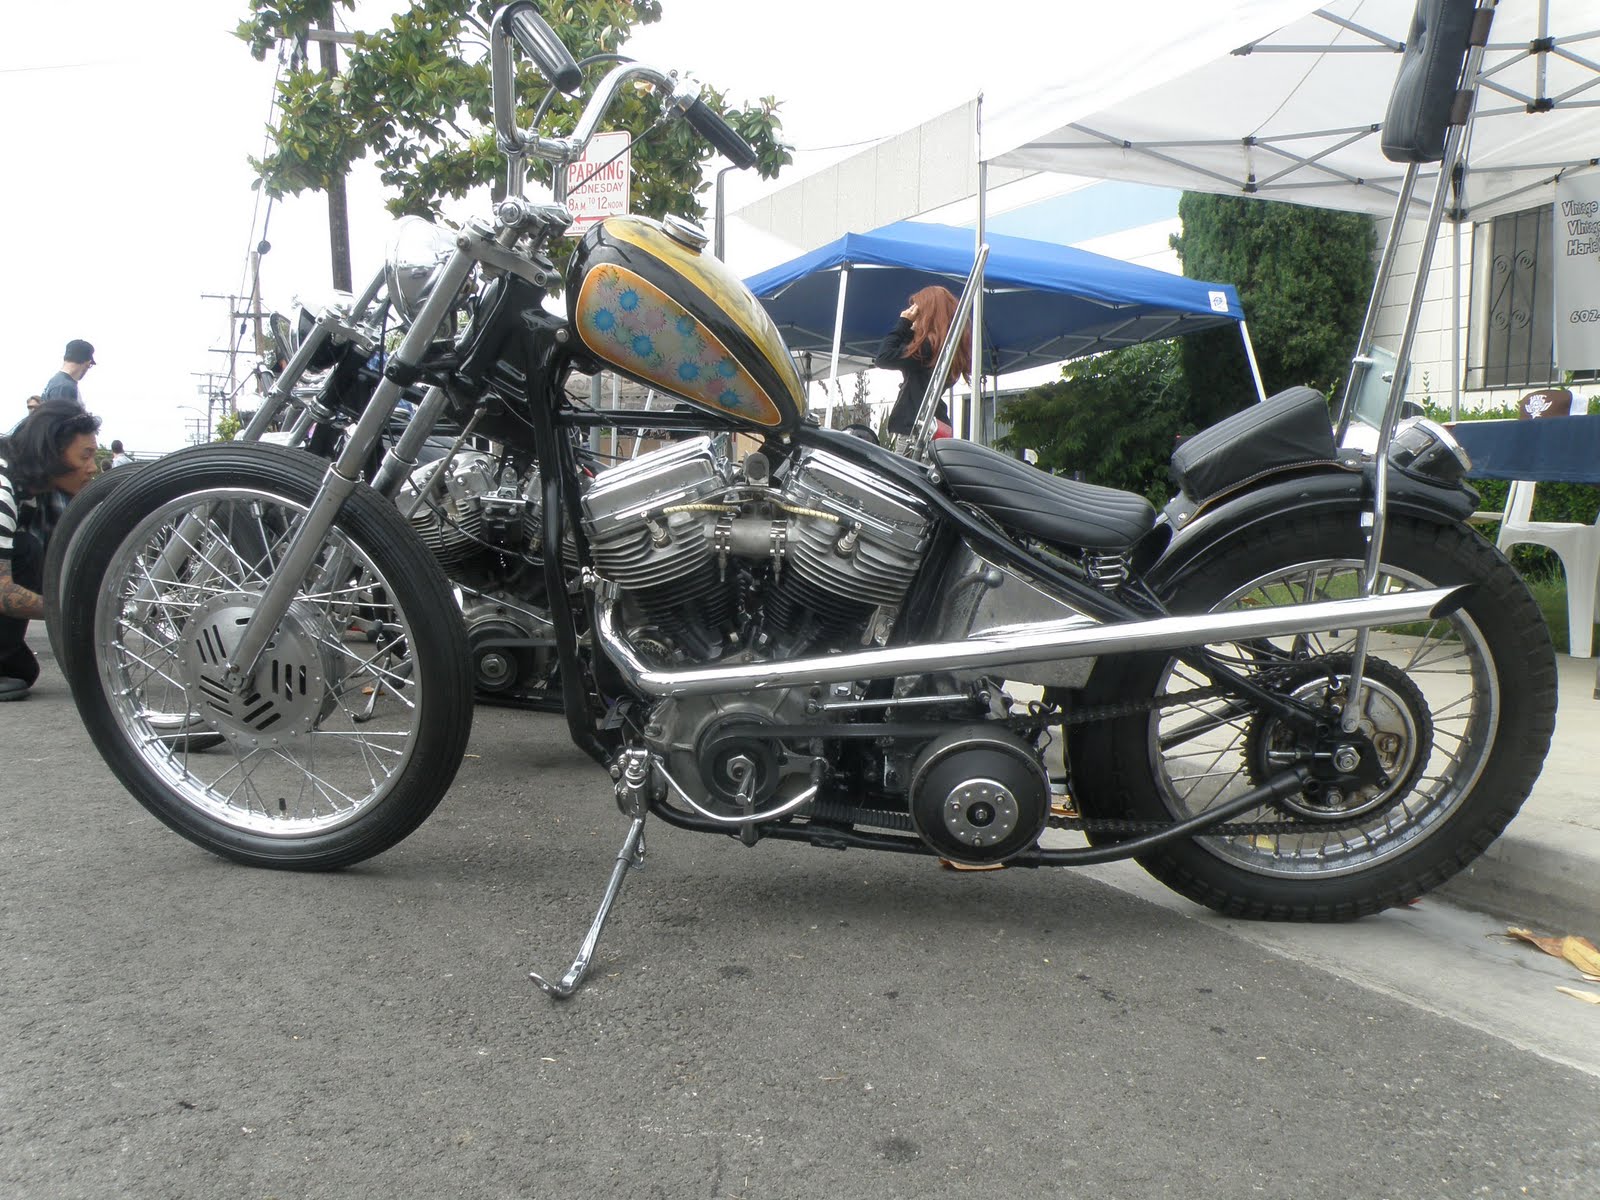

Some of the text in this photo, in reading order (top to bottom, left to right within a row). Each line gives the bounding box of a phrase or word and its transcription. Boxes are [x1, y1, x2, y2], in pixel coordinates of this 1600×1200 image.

[569, 161, 624, 182] PARKING
[568, 183, 624, 195] WEDNESDAY
[588, 197, 596, 205] TO
[1567, 238, 1600, 256] Harle
